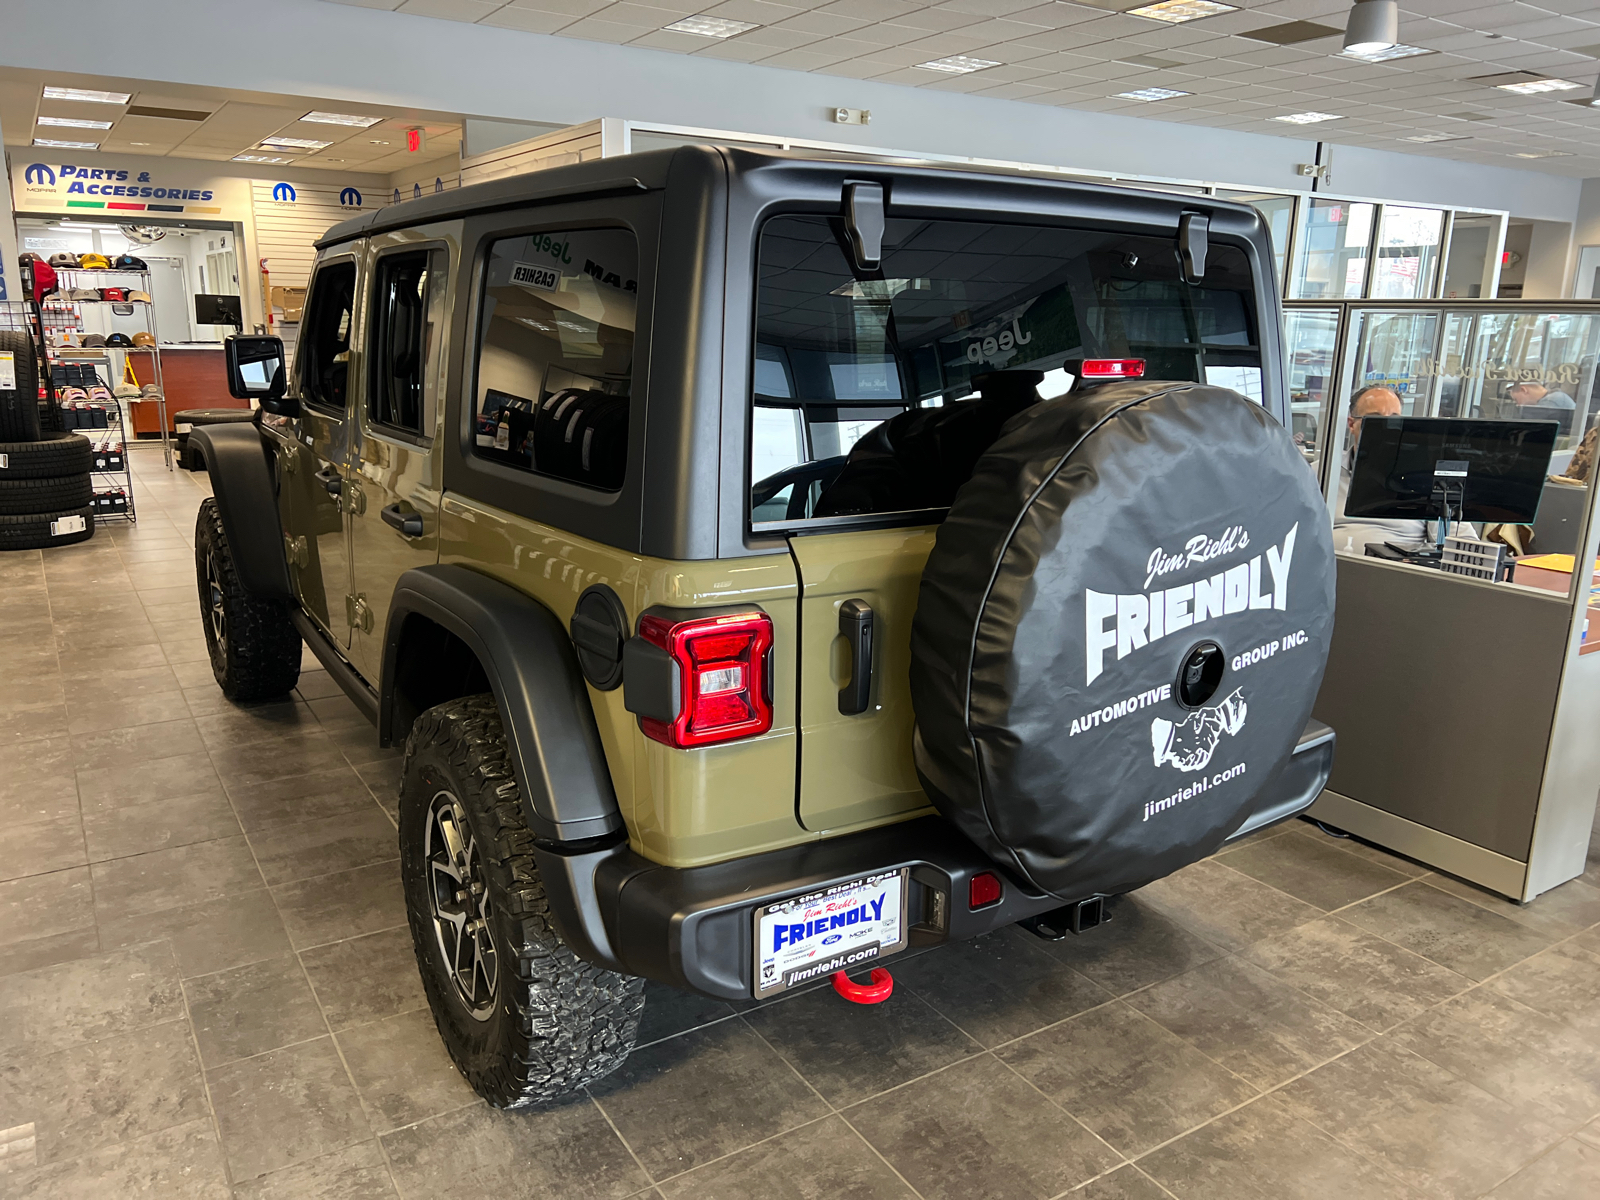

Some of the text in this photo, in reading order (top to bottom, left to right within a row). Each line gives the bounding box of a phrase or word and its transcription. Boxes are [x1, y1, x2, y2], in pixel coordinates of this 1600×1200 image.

[67, 181, 213, 201] ACCESSORIES
[137, 172, 152, 182] &
[1144, 525, 1250, 589] Jim Riehl's
[1454, 553, 1484, 566] DEALS
[1456, 541, 1486, 554] RIEHL
[1085, 520, 1299, 687] FRIENDLY
[1069, 629, 1309, 736] AUTOMOTIVE GROUP INC.
[1143, 762, 1246, 821] jimriehl.com
[798, 893, 823, 904] the
[827, 880, 863, 895] Riehl
[866, 870, 897, 884] Deal
[773, 891, 887, 954] FRIENDLY
[803, 898, 858, 922] Jim Riehl's
[849, 927, 873, 938] MOKE
[787, 946, 878, 987] jimriehl.com
